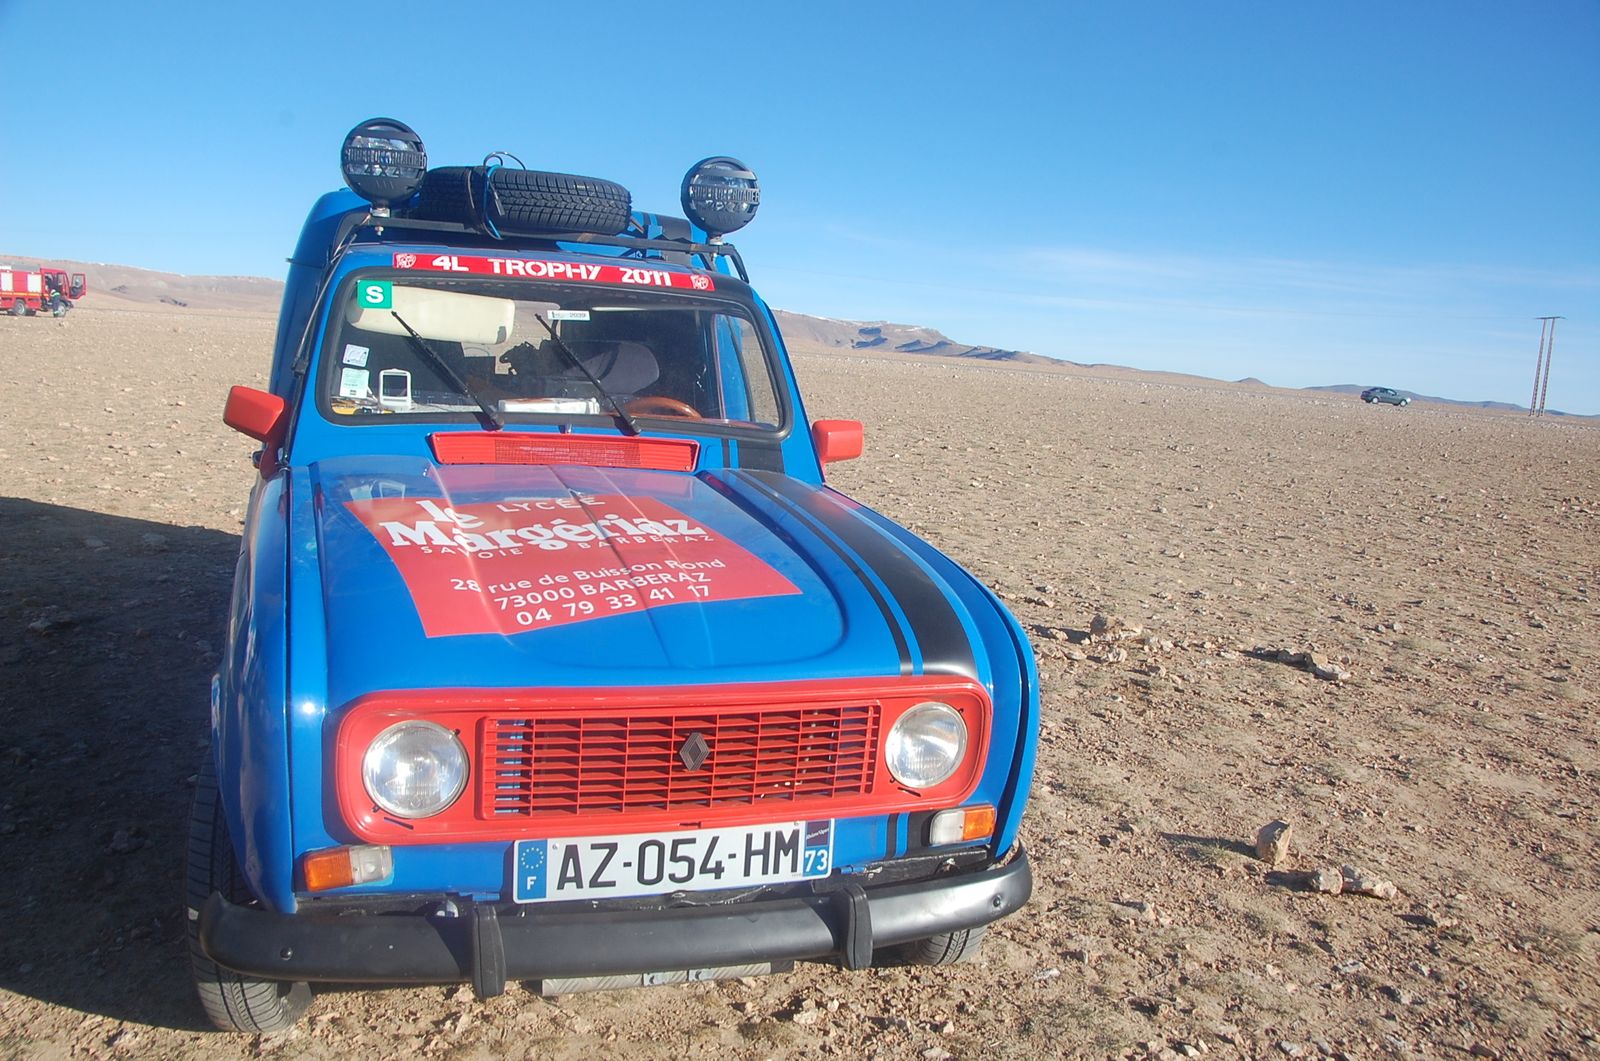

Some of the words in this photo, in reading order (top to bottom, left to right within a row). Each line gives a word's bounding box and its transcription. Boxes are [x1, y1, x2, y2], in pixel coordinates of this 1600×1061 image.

[432, 255, 469, 271] 4L
[487, 258, 602, 280] TROPHY
[619, 267, 672, 286] 2011
[366, 285, 384, 303] S
[416, 500, 484, 528] le
[378, 514, 707, 552] Margériaz
[420, 545, 523, 559] SAVOIE
[577, 535, 714, 549] BARBERAZ
[450, 579, 482, 592] 28
[488, 580, 532, 594] rue
[538, 574, 569, 585] de
[572, 562, 663, 580] Buisson
[664, 559, 726, 570] Rond
[494, 587, 575, 610] 73000
[579, 572, 712, 596] BARBERAZ
[516, 608, 552, 625] 04
[562, 601, 594, 617] 79
[605, 594, 637, 609] 33
[649, 587, 675, 600] 41
[687, 585, 710, 597] 17
[526, 876, 537, 891] F
[557, 829, 800, 890] AZ-054-HM
[805, 849, 828, 872] 73
